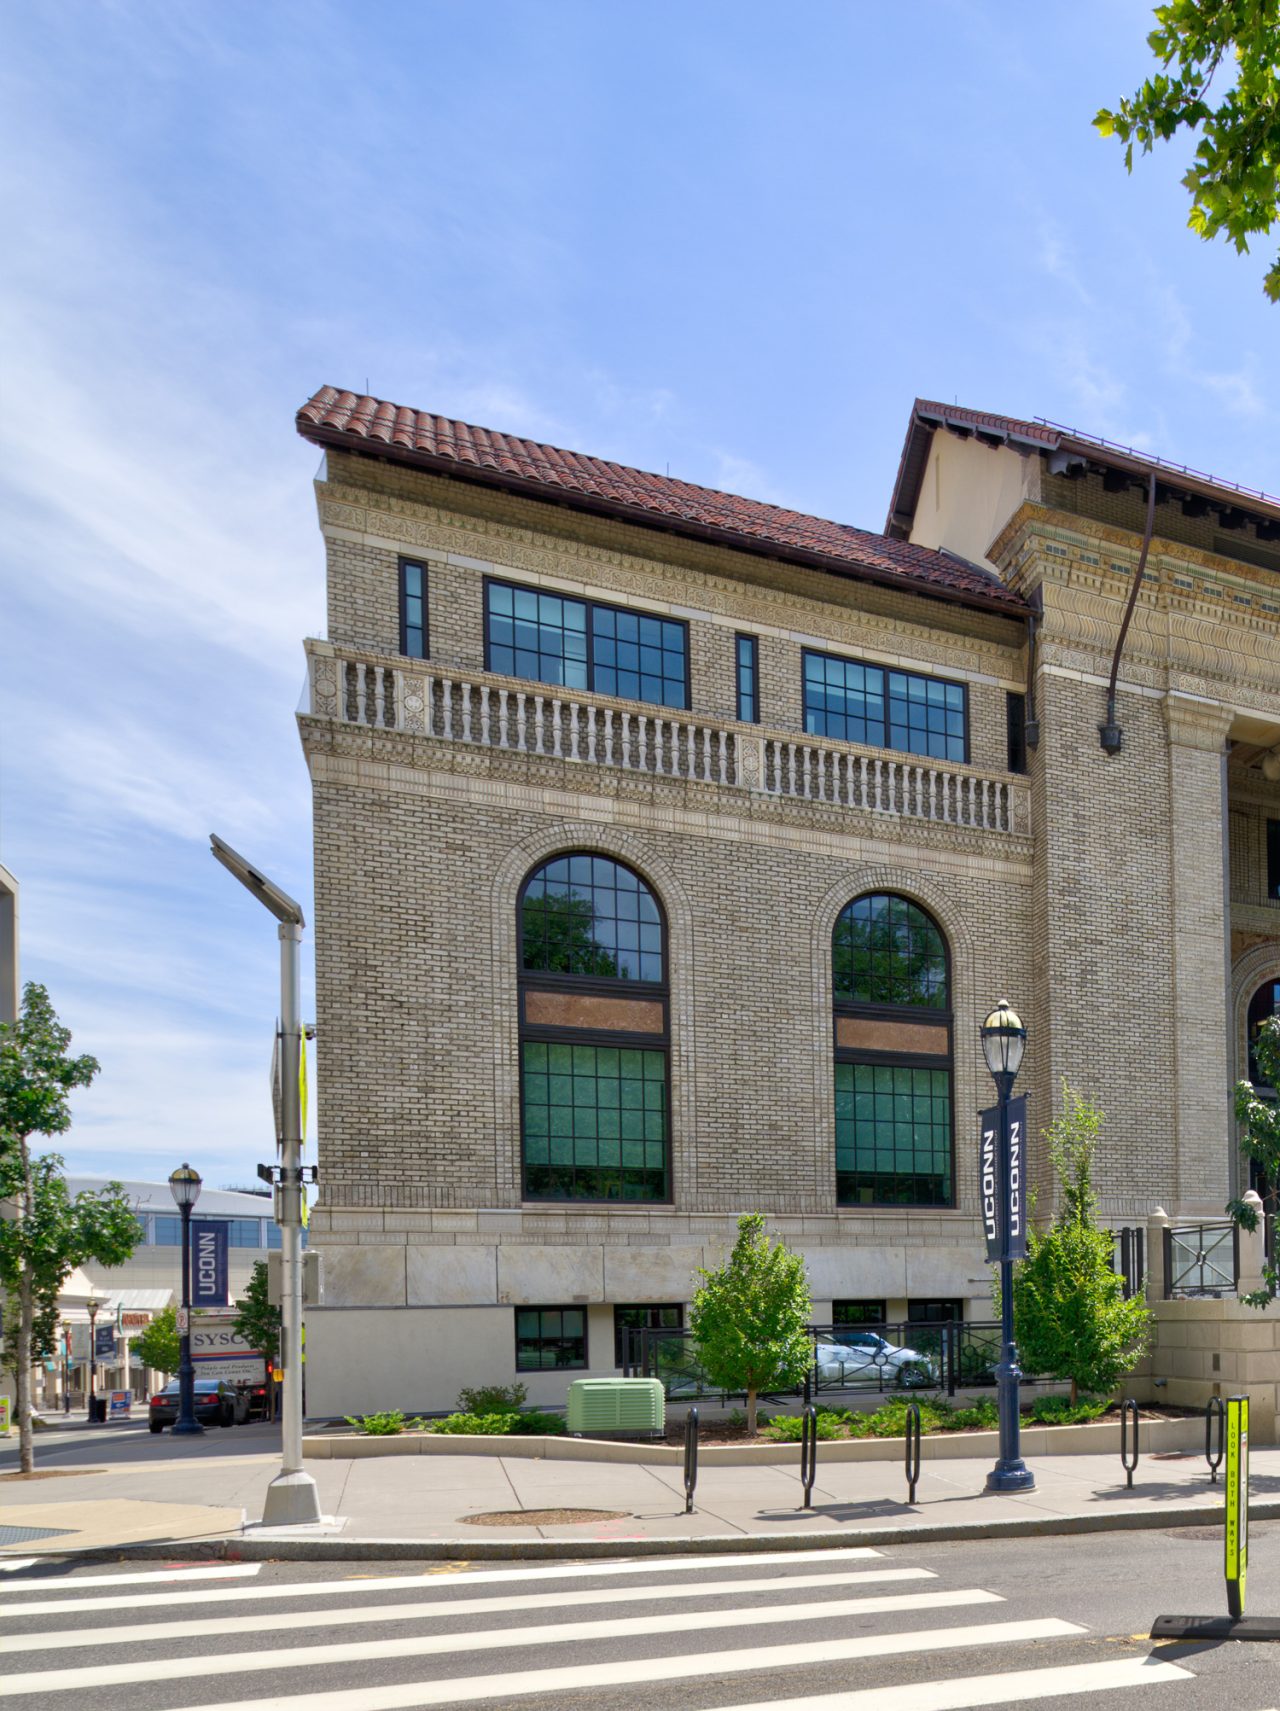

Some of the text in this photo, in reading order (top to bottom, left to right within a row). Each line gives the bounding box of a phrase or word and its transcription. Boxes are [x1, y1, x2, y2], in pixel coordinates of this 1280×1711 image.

[983, 1130, 996, 1239] UCONN
[1010, 1121, 1019, 1237] UCONN
[198, 1232, 216, 1295] UCONN
[194, 1333, 246, 1347] SYSC
